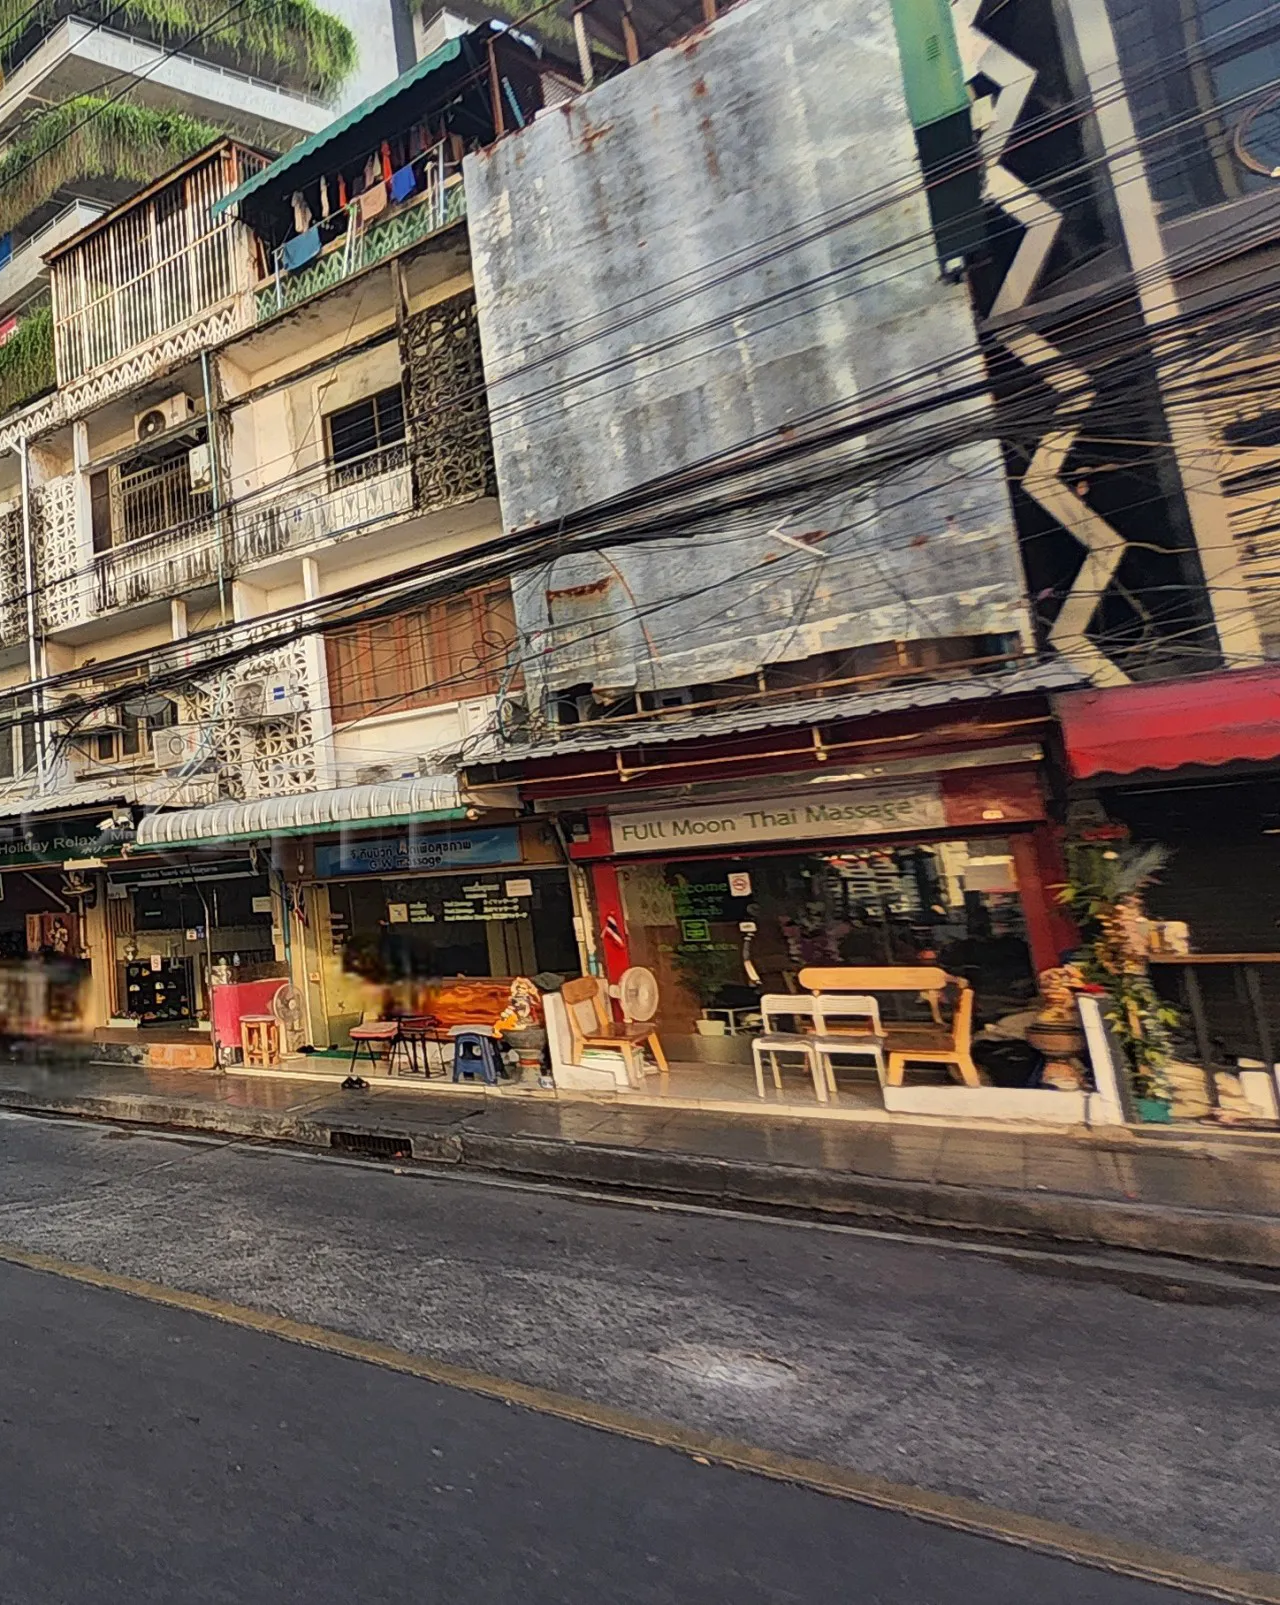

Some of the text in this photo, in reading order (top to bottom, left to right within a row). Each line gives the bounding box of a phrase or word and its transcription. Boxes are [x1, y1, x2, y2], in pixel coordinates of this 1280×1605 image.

[673, 818, 736, 837] Moon
[744, 808, 798, 829] Thai
[805, 800, 912, 823] Massage
